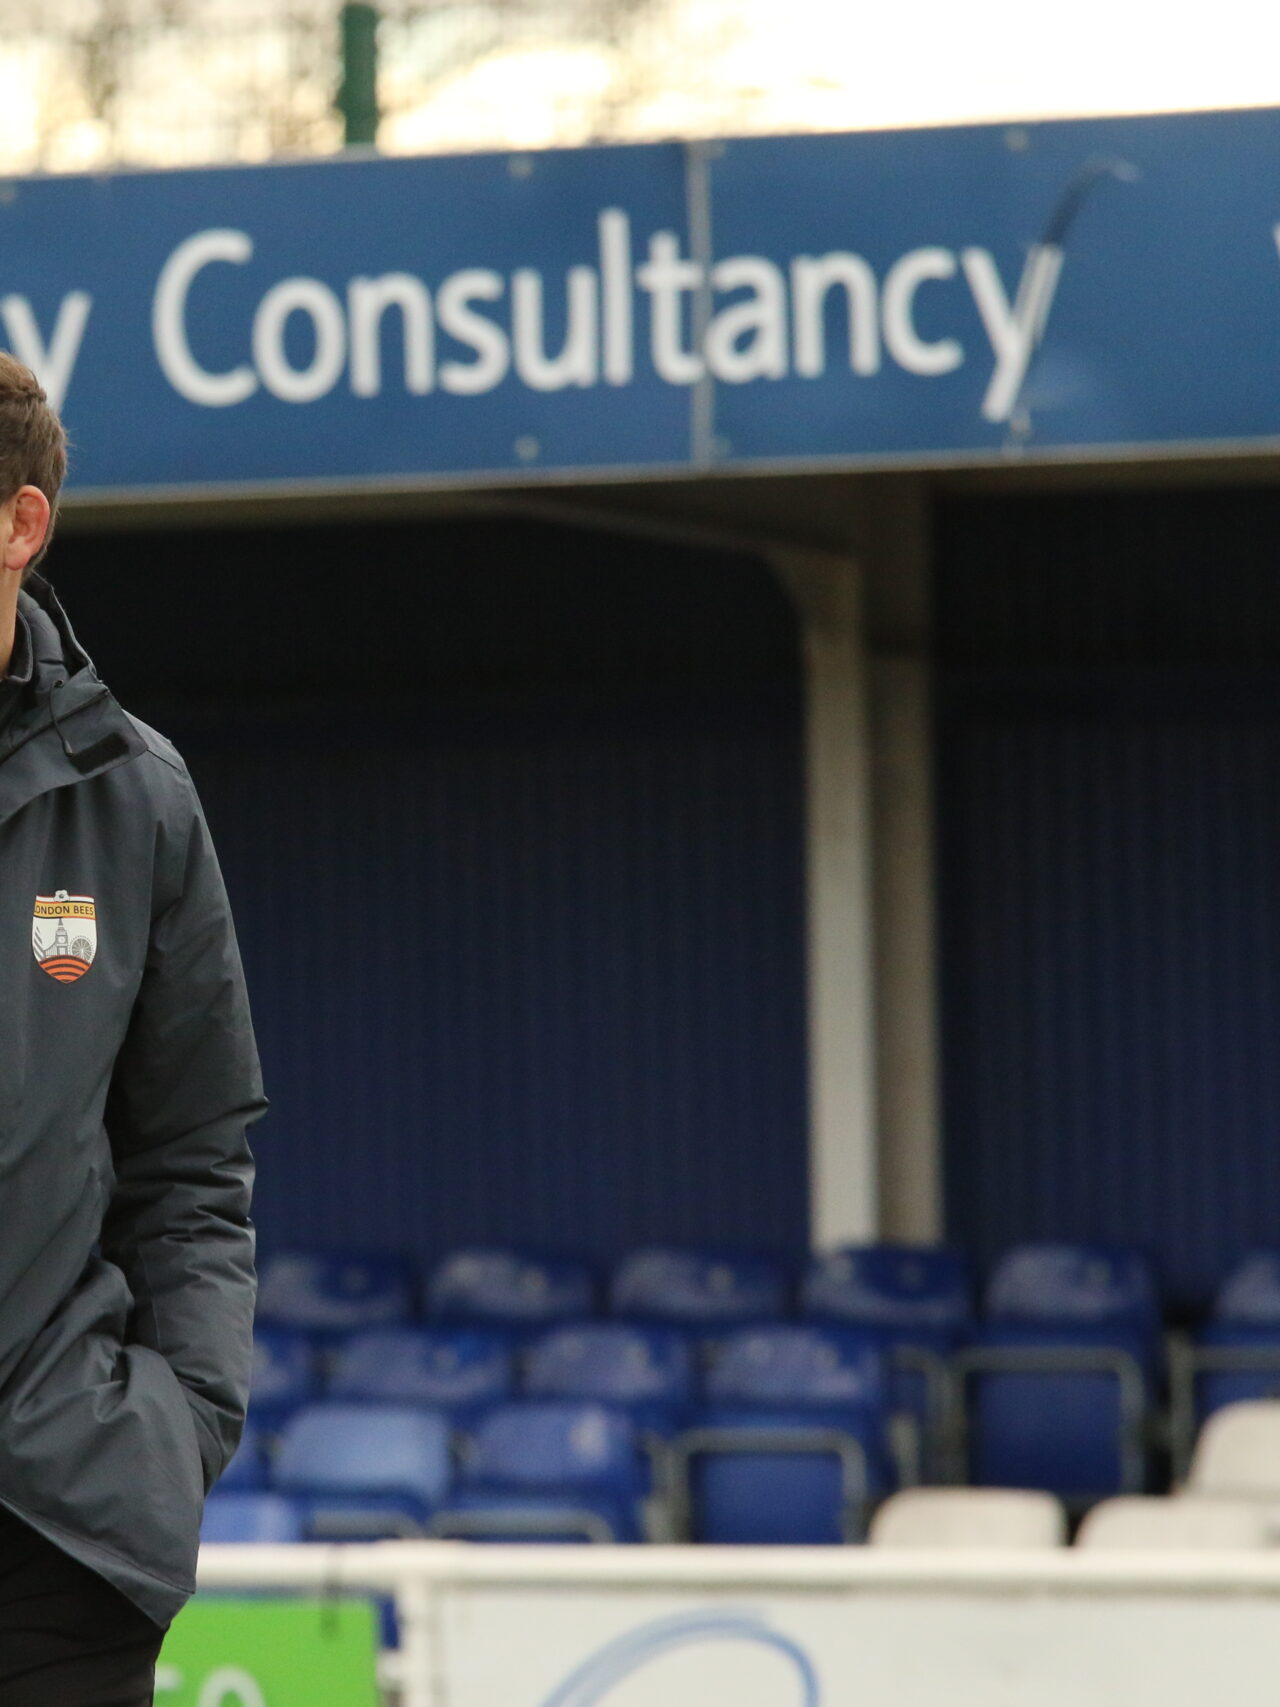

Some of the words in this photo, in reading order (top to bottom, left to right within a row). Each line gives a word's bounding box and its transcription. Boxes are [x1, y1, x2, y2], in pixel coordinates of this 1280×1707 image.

[152, 207, 1064, 422] Consultancy
[34, 904, 70, 915] ONDON
[73, 905, 94, 916] BEES
